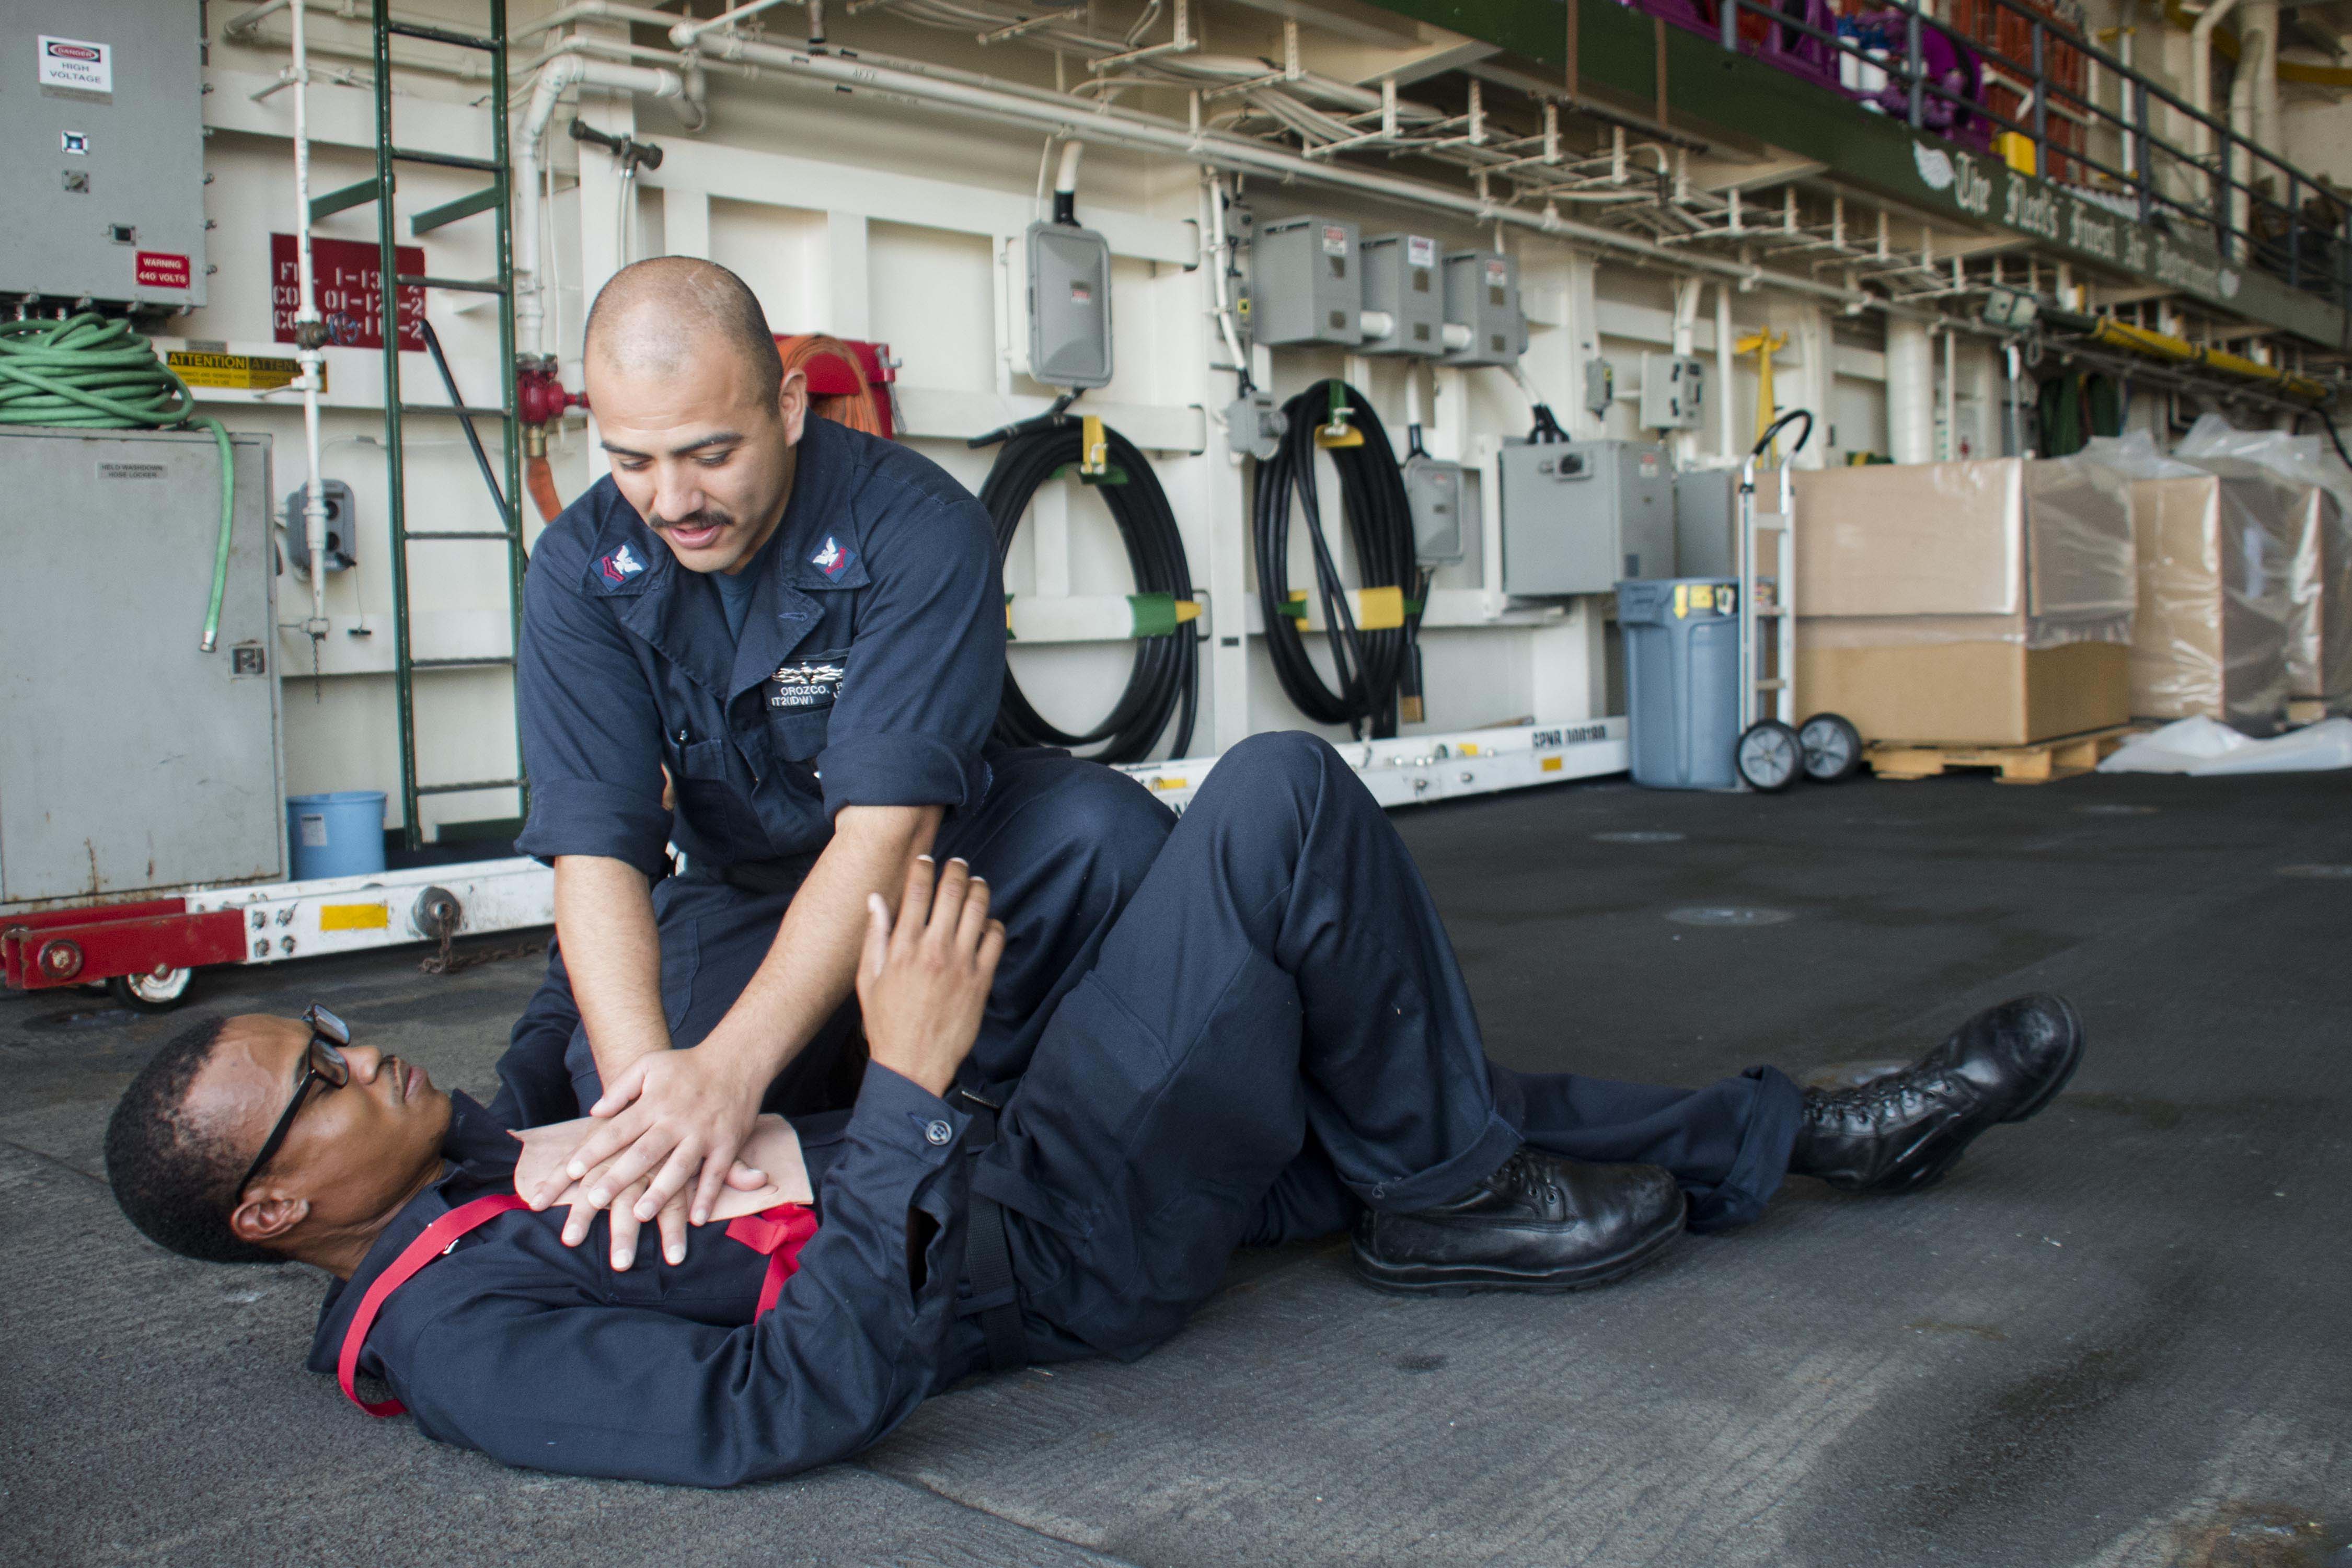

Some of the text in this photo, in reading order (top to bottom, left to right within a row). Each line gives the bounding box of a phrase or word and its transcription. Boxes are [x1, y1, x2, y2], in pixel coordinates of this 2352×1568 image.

[57, 48, 93, 57] DANGER
[62, 63, 89, 72] HIGH
[50, 71, 101, 84] VOLTAGE
[143, 258, 181, 270] WARNING
[139, 272, 186, 284] 440 VOLTS
[169, 353, 245, 368] ATTENTION
[771, 696, 813, 707] IT2(IDW)
